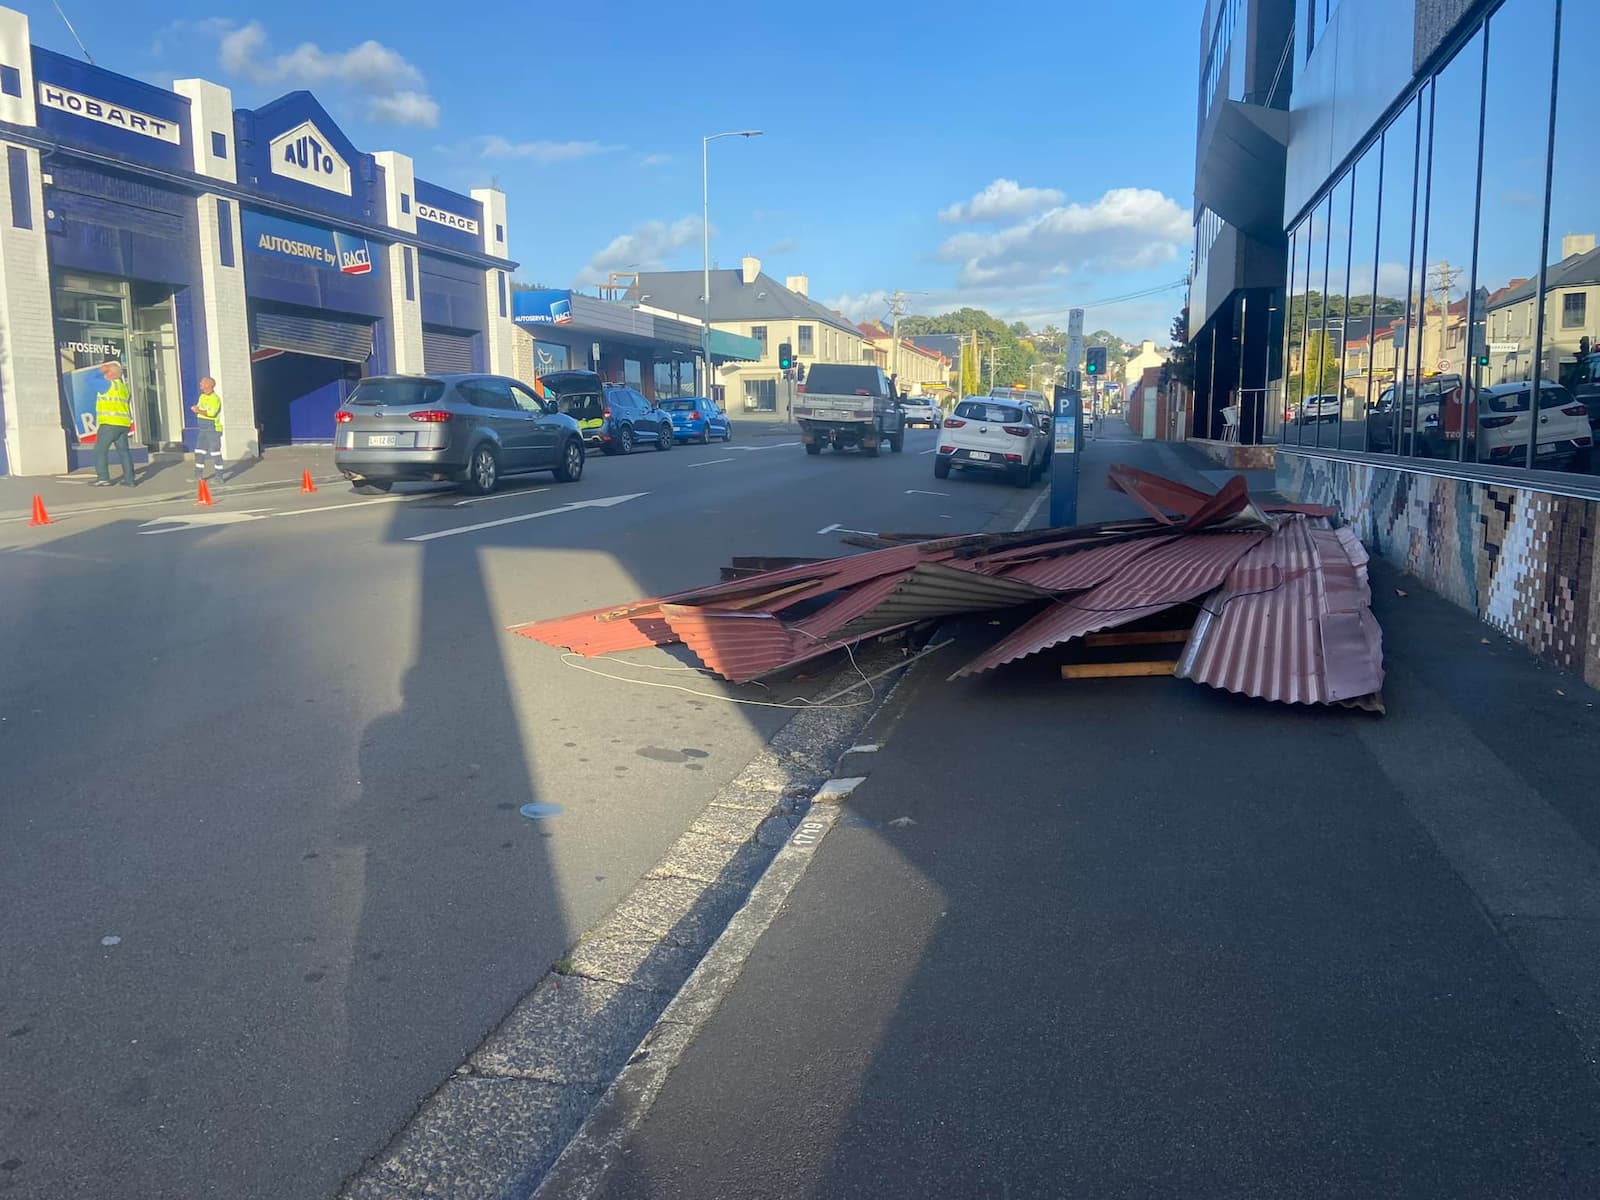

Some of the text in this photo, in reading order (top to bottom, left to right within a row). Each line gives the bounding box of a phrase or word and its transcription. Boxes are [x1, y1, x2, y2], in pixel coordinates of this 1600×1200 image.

[46, 88, 166, 135] HOBART
[284, 135, 334, 175] AUTO
[418, 206, 475, 230] GARAGE
[258, 234, 366, 267] AUTOSERVE by RACT
[60, 342, 121, 358] TOSERVE by
[1060, 399, 1069, 414] P
[792, 822, 824, 845] 1719
